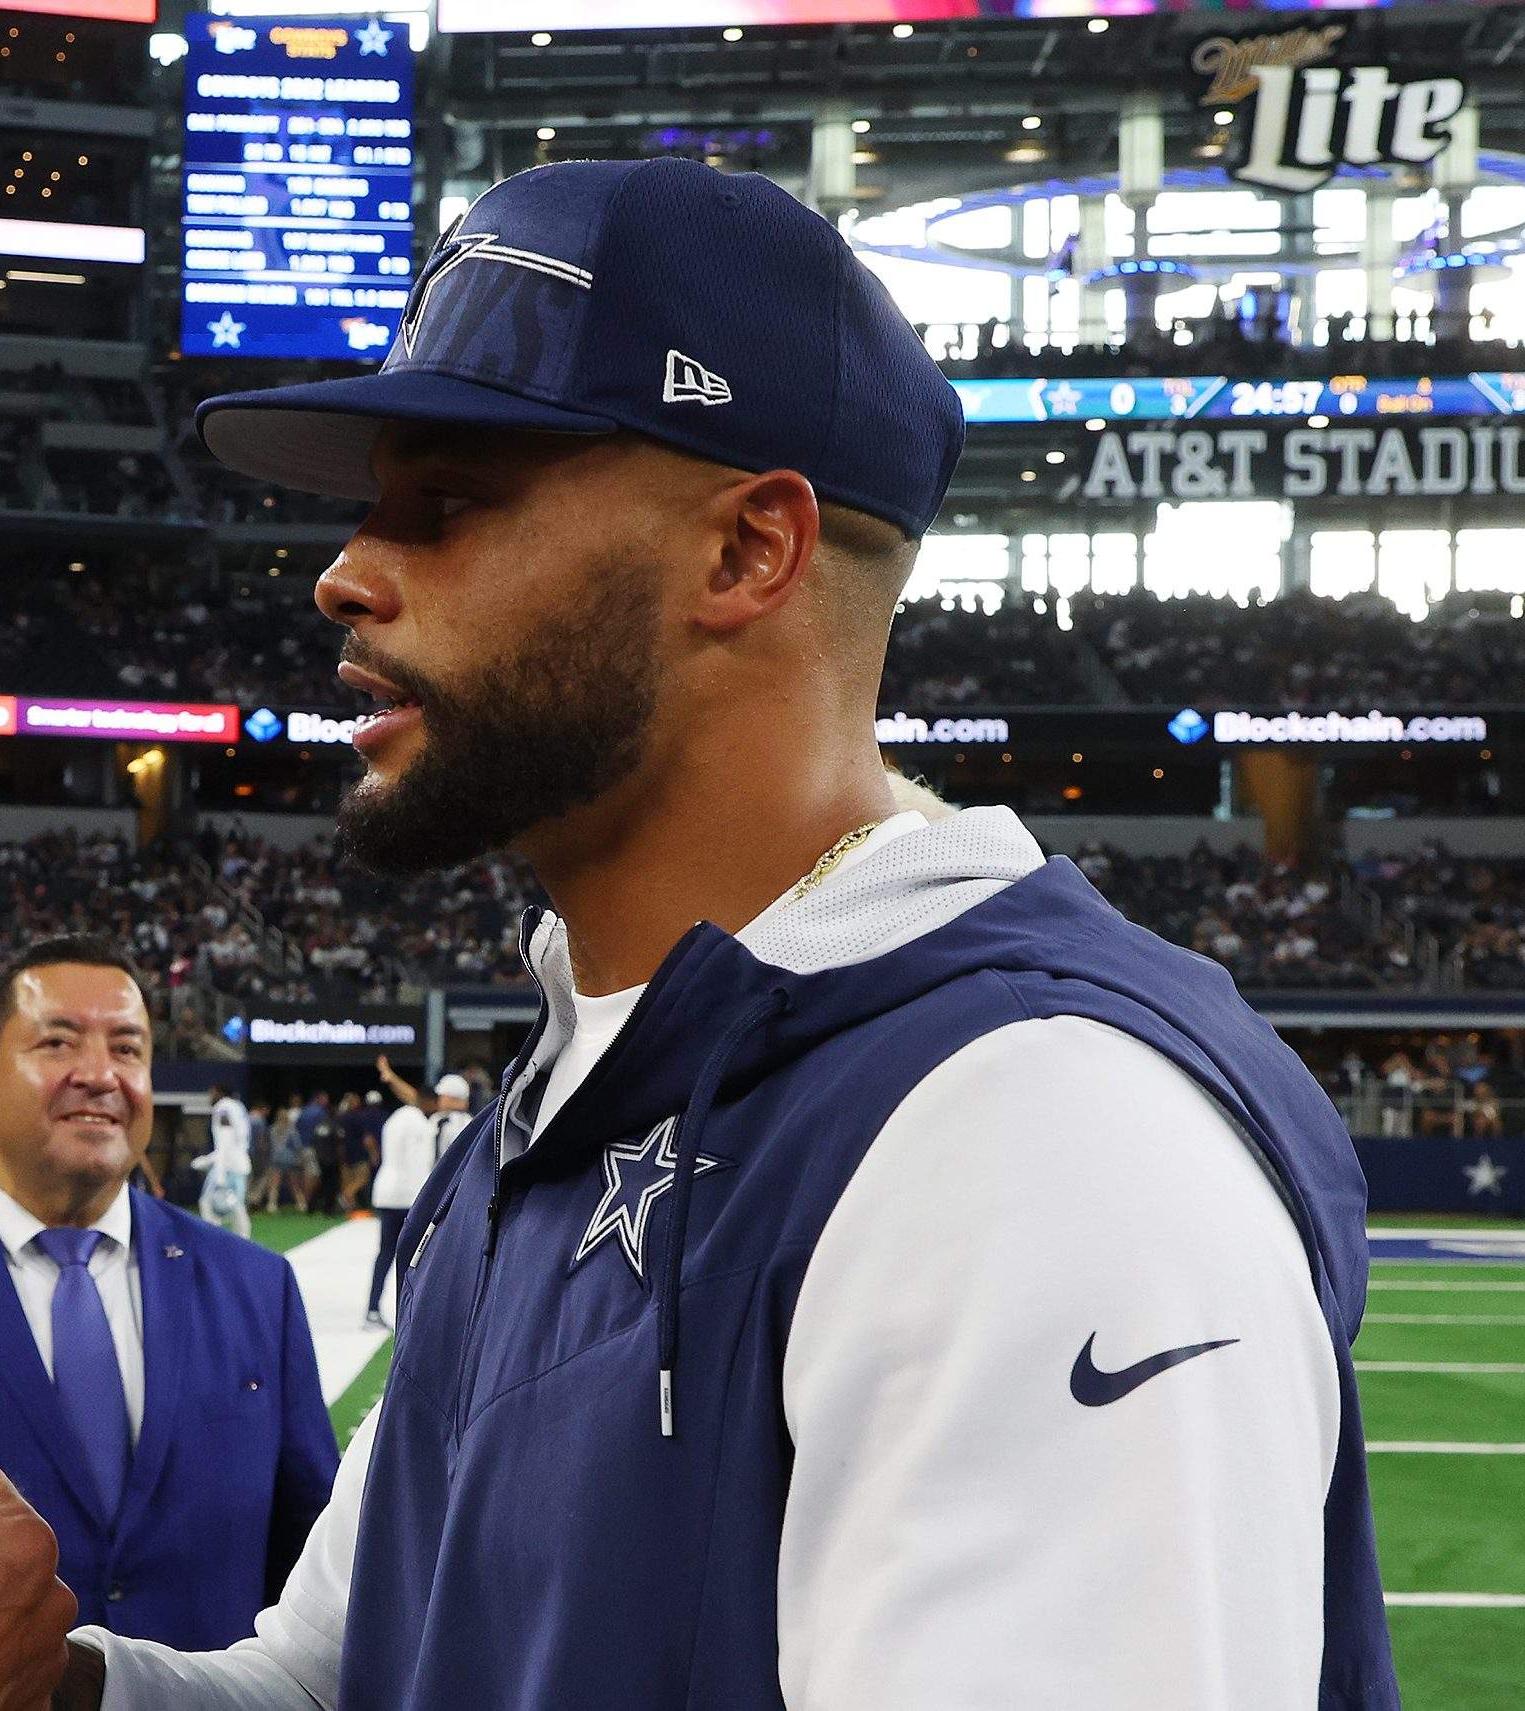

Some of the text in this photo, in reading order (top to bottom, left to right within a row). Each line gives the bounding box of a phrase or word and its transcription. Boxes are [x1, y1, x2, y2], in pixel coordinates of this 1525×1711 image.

[1235, 65, 1464, 192] Lite
[1109, 383, 1136, 415] 0
[1230, 381, 1324, 415] 24:57
[1083, 430, 1266, 498] AT&T
[1213, 709, 1487, 743] Blockchain.com
[250, 1018, 416, 1045] Blockchain.com
